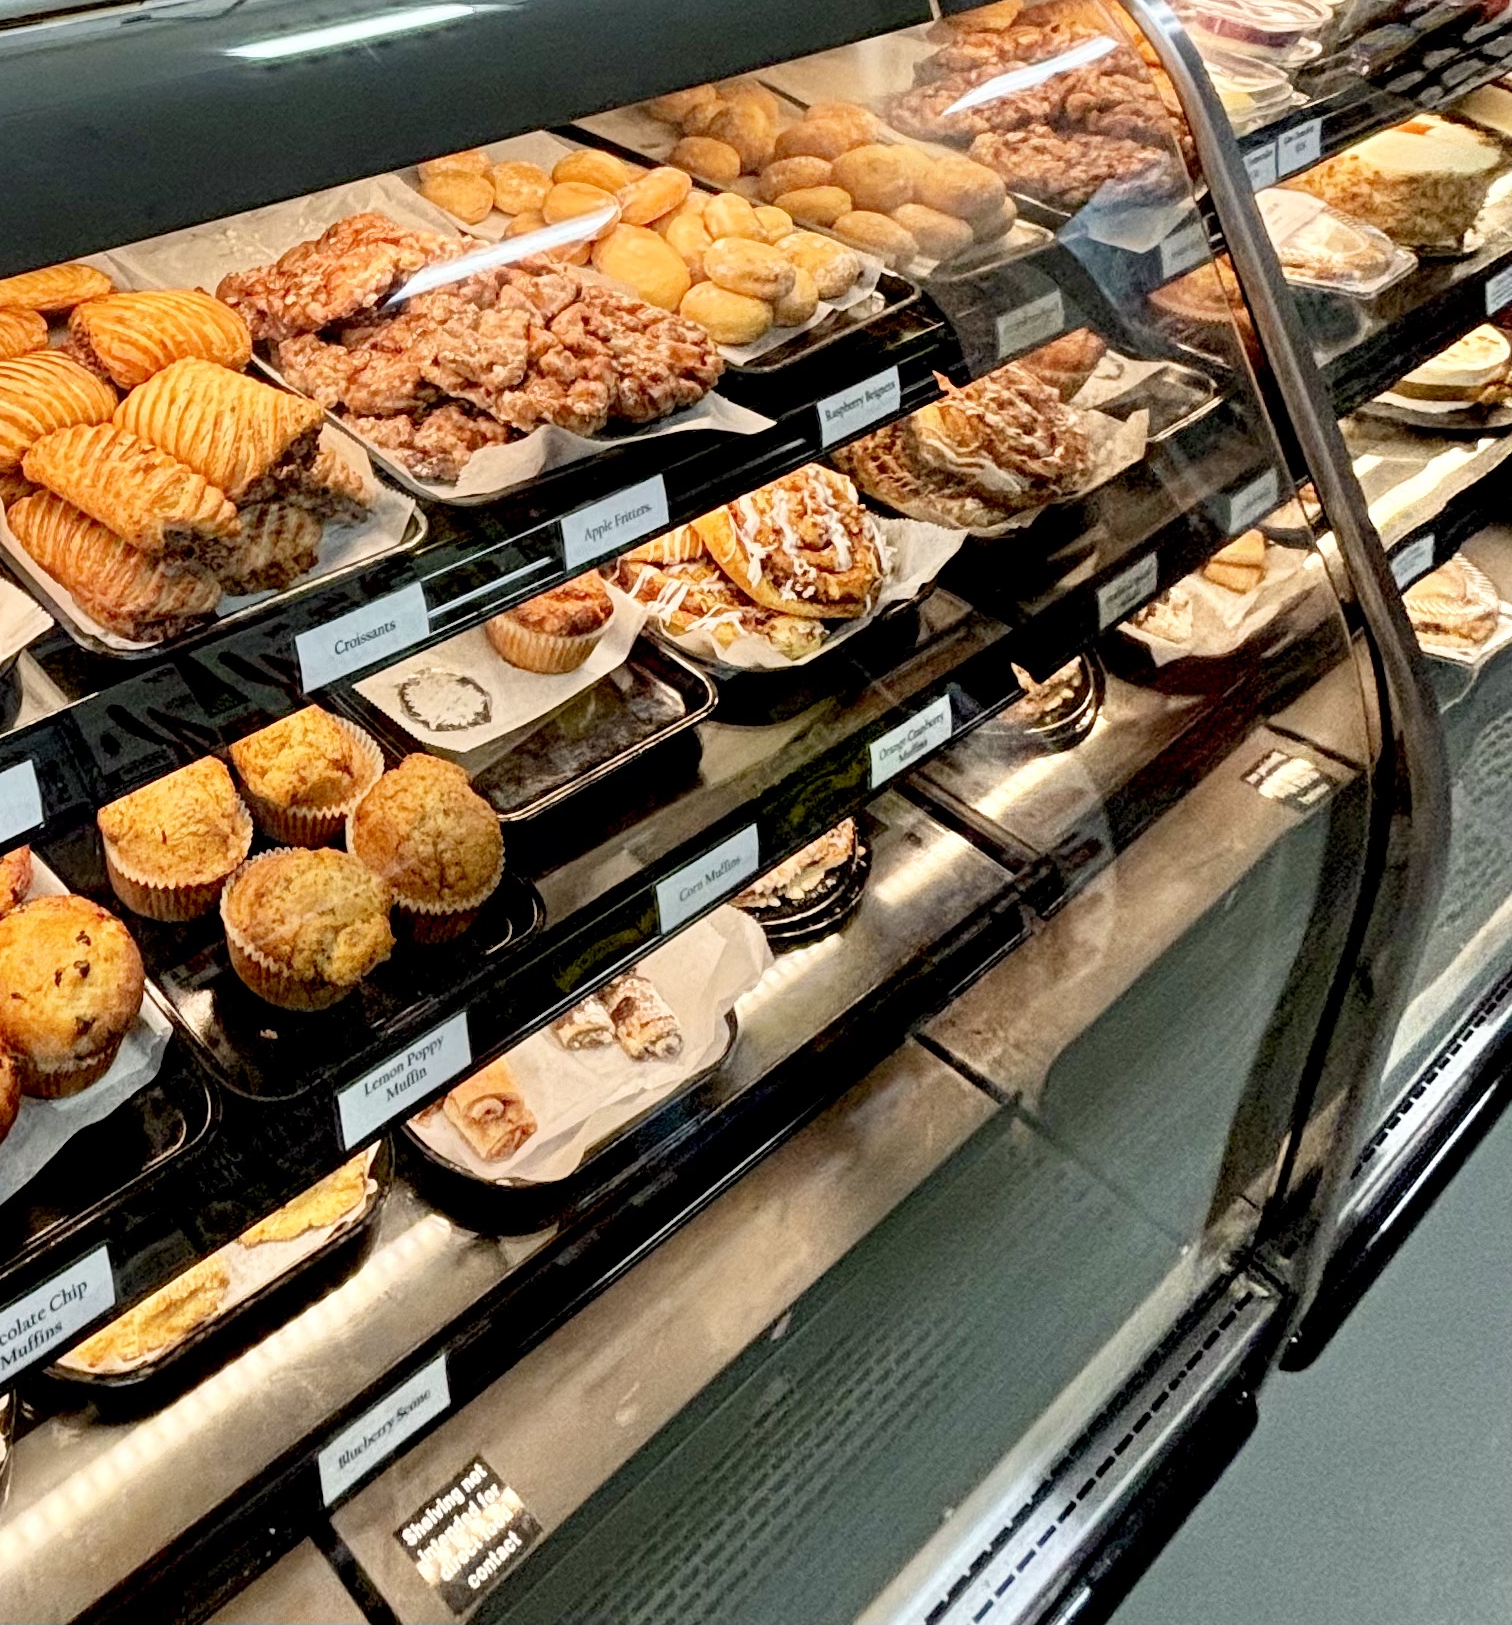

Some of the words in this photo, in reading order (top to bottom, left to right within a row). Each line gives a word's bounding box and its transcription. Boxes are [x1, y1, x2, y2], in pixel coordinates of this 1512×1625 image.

[824, 395, 865, 423] Raspberry
[583, 517, 613, 542] Apple
[333, 618, 398, 656] Croissants
[679, 880, 704, 902] Corn
[704, 857, 742, 885] Muffins
[363, 1062, 405, 1098] Lemon
[407, 1034, 444, 1068] Poppy
[385, 1067, 429, 1103] Muffin
[48, 1280, 89, 1313] Chip
[0, 1320, 64, 1371] Muffins
[337, 1411, 396, 1470] Blueberry
[401, 1487, 466, 1547] Shelving
[460, 1461, 489, 1494] not
[416, 1500, 481, 1565] intended
[476, 1482, 502, 1516] for
[439, 1535, 485, 1582] direct
[466, 1530, 523, 1590] contact
